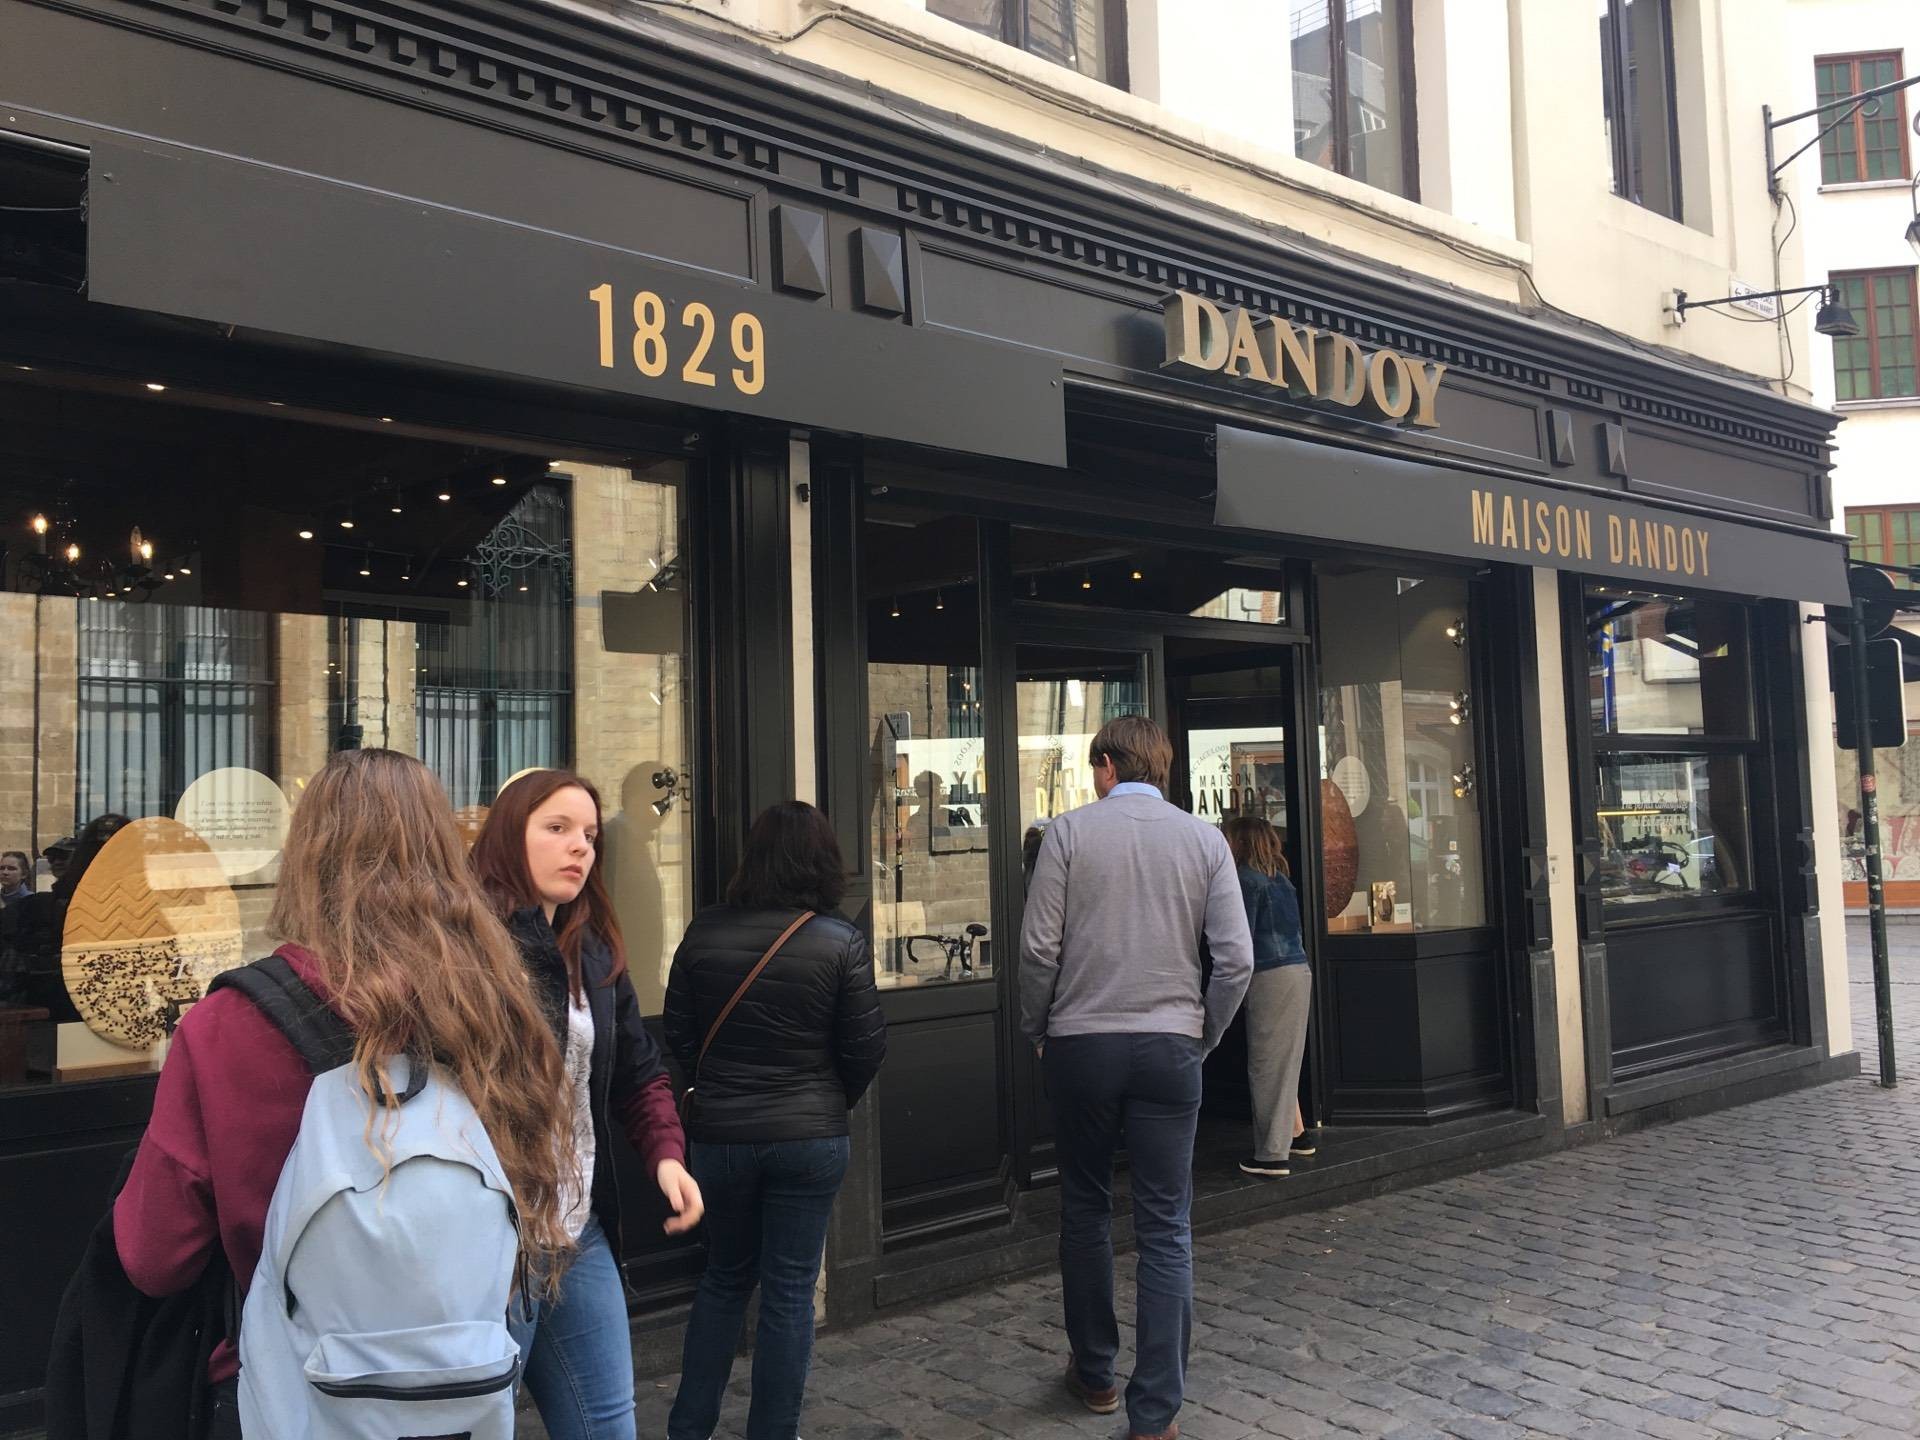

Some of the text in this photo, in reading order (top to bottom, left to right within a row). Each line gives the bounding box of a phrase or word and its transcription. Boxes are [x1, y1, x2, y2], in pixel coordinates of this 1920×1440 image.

[589, 283, 765, 395] 1829
[1172, 289, 1447, 428] DANDOY
[1471, 489, 1709, 577] MAISON DANDOY
[1188, 786, 1266, 815] ANDO
[1199, 773, 1252, 788] MAISON
